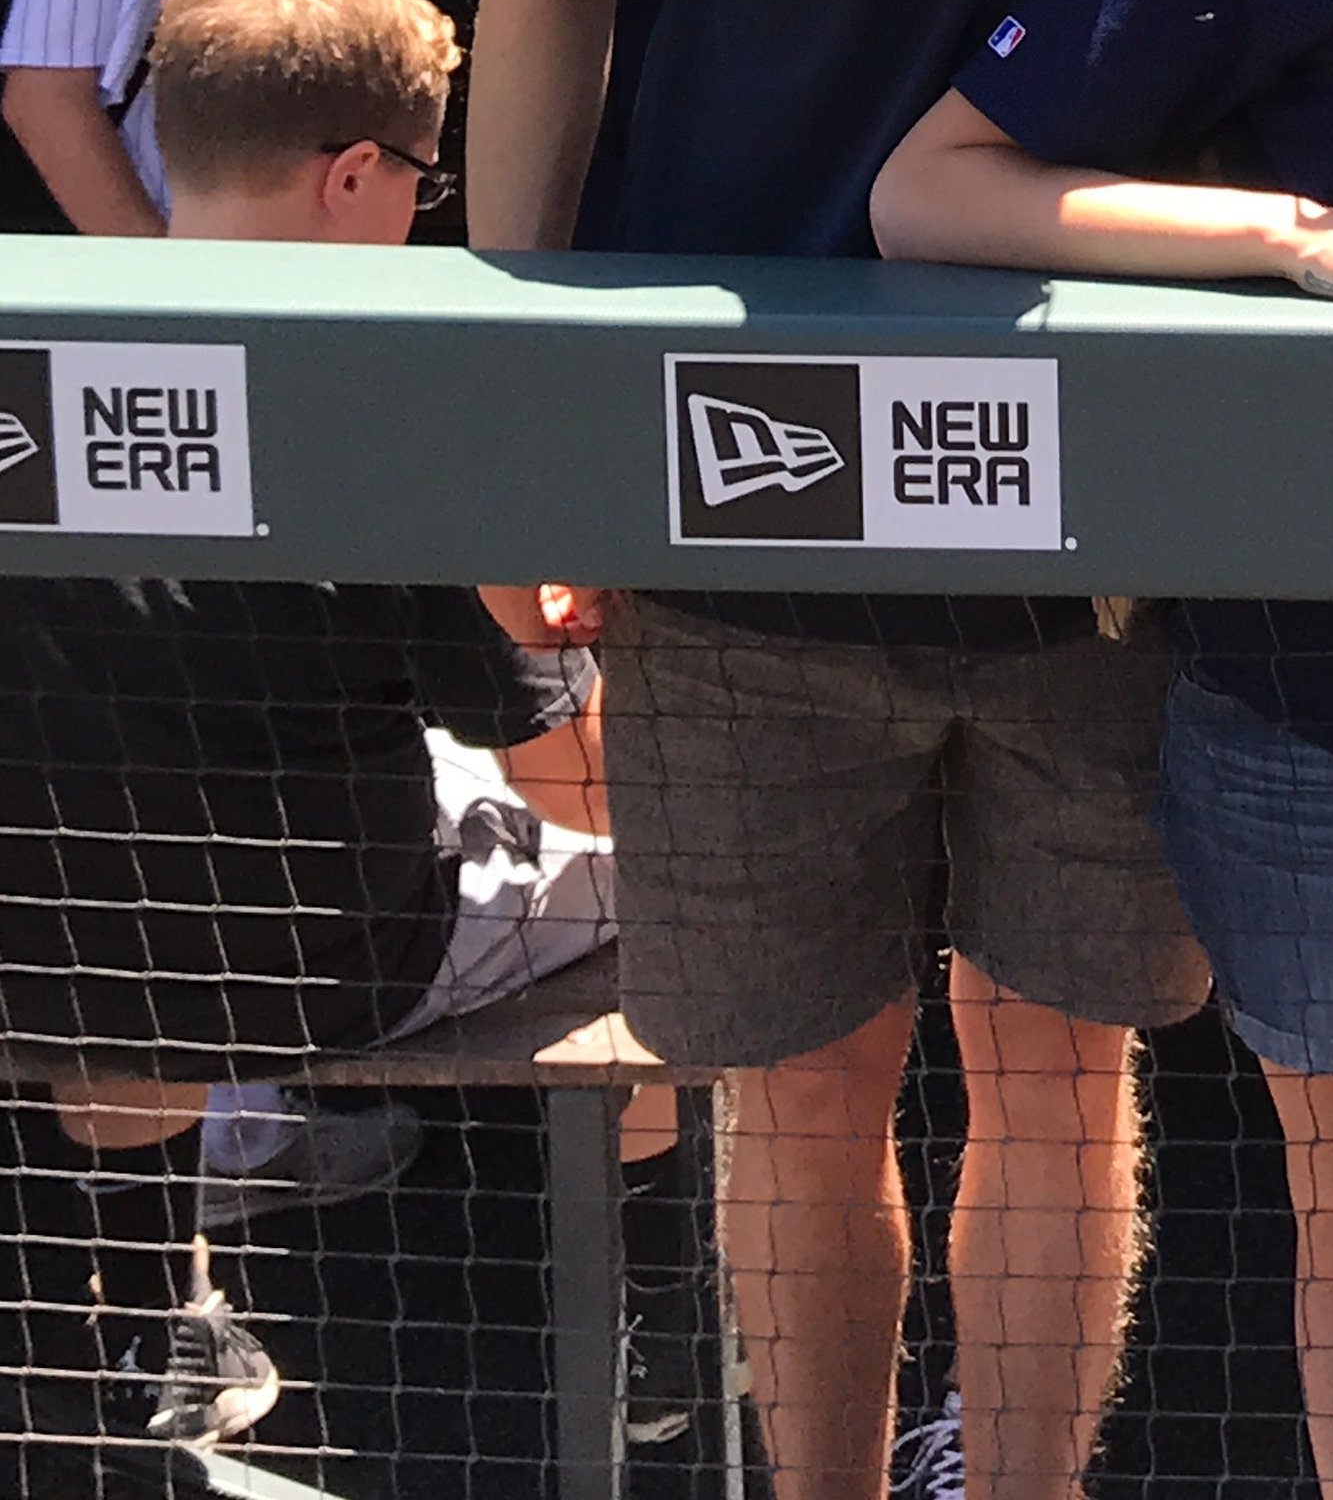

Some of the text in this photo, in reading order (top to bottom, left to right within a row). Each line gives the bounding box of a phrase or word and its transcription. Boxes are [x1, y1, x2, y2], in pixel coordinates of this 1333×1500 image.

[82, 386, 218, 438] NEW
[891, 400, 1029, 451] NEW
[86, 441, 221, 492] ERA
[893, 455, 1030, 507] ERA
